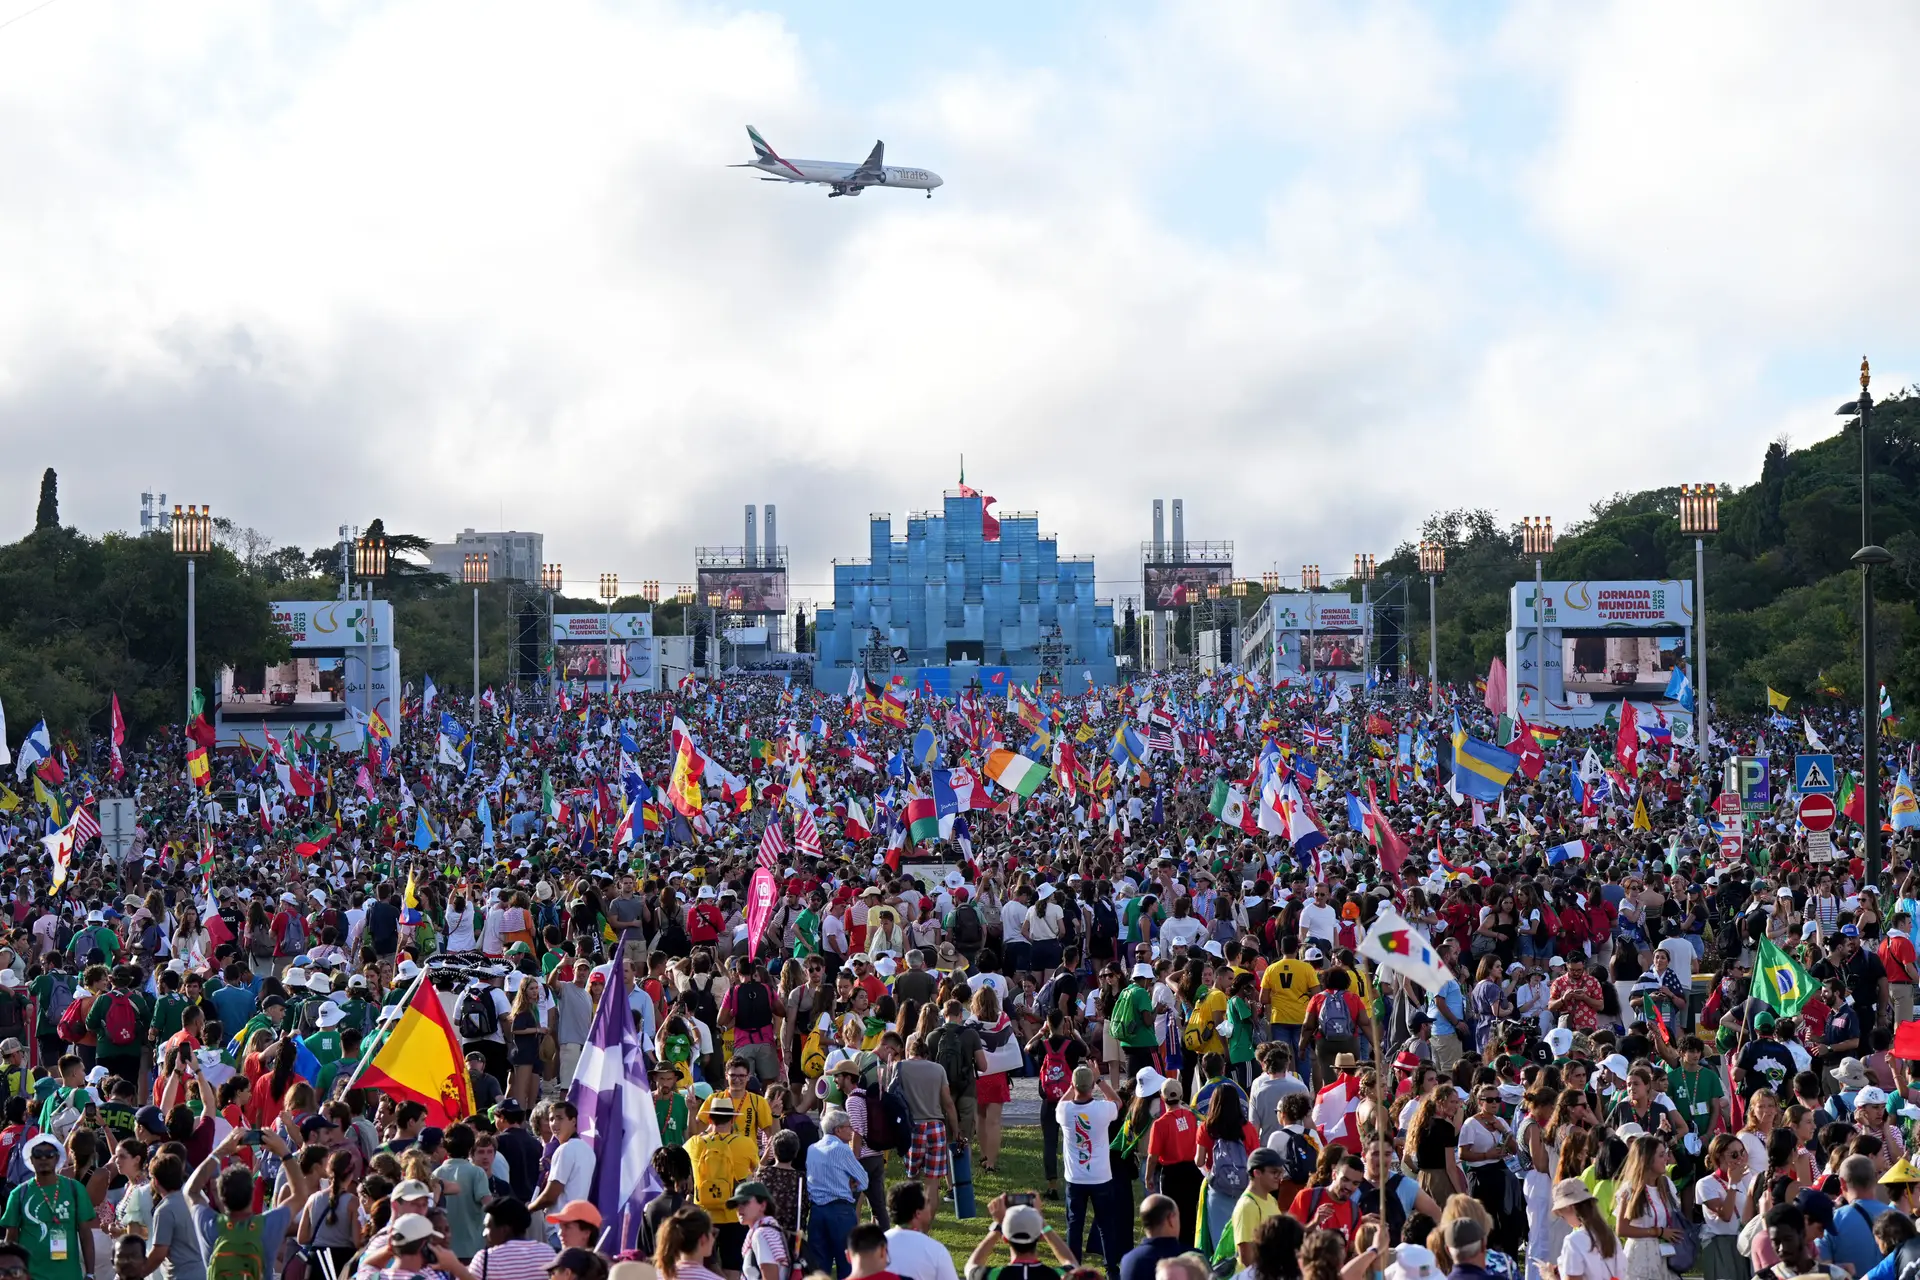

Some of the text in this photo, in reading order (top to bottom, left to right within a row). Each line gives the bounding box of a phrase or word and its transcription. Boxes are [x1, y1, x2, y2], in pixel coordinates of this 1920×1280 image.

[1598, 590, 1650, 600] JORNADA
[1598, 601, 1650, 610] MUNDIAL
[1608, 611, 1665, 620] JUVENTUDE
[1742, 761, 1765, 799] P
[1753, 791, 1767, 799] 24H
[1743, 802, 1765, 810] LIVRE
[1538, 1049, 1547, 1060] 9
